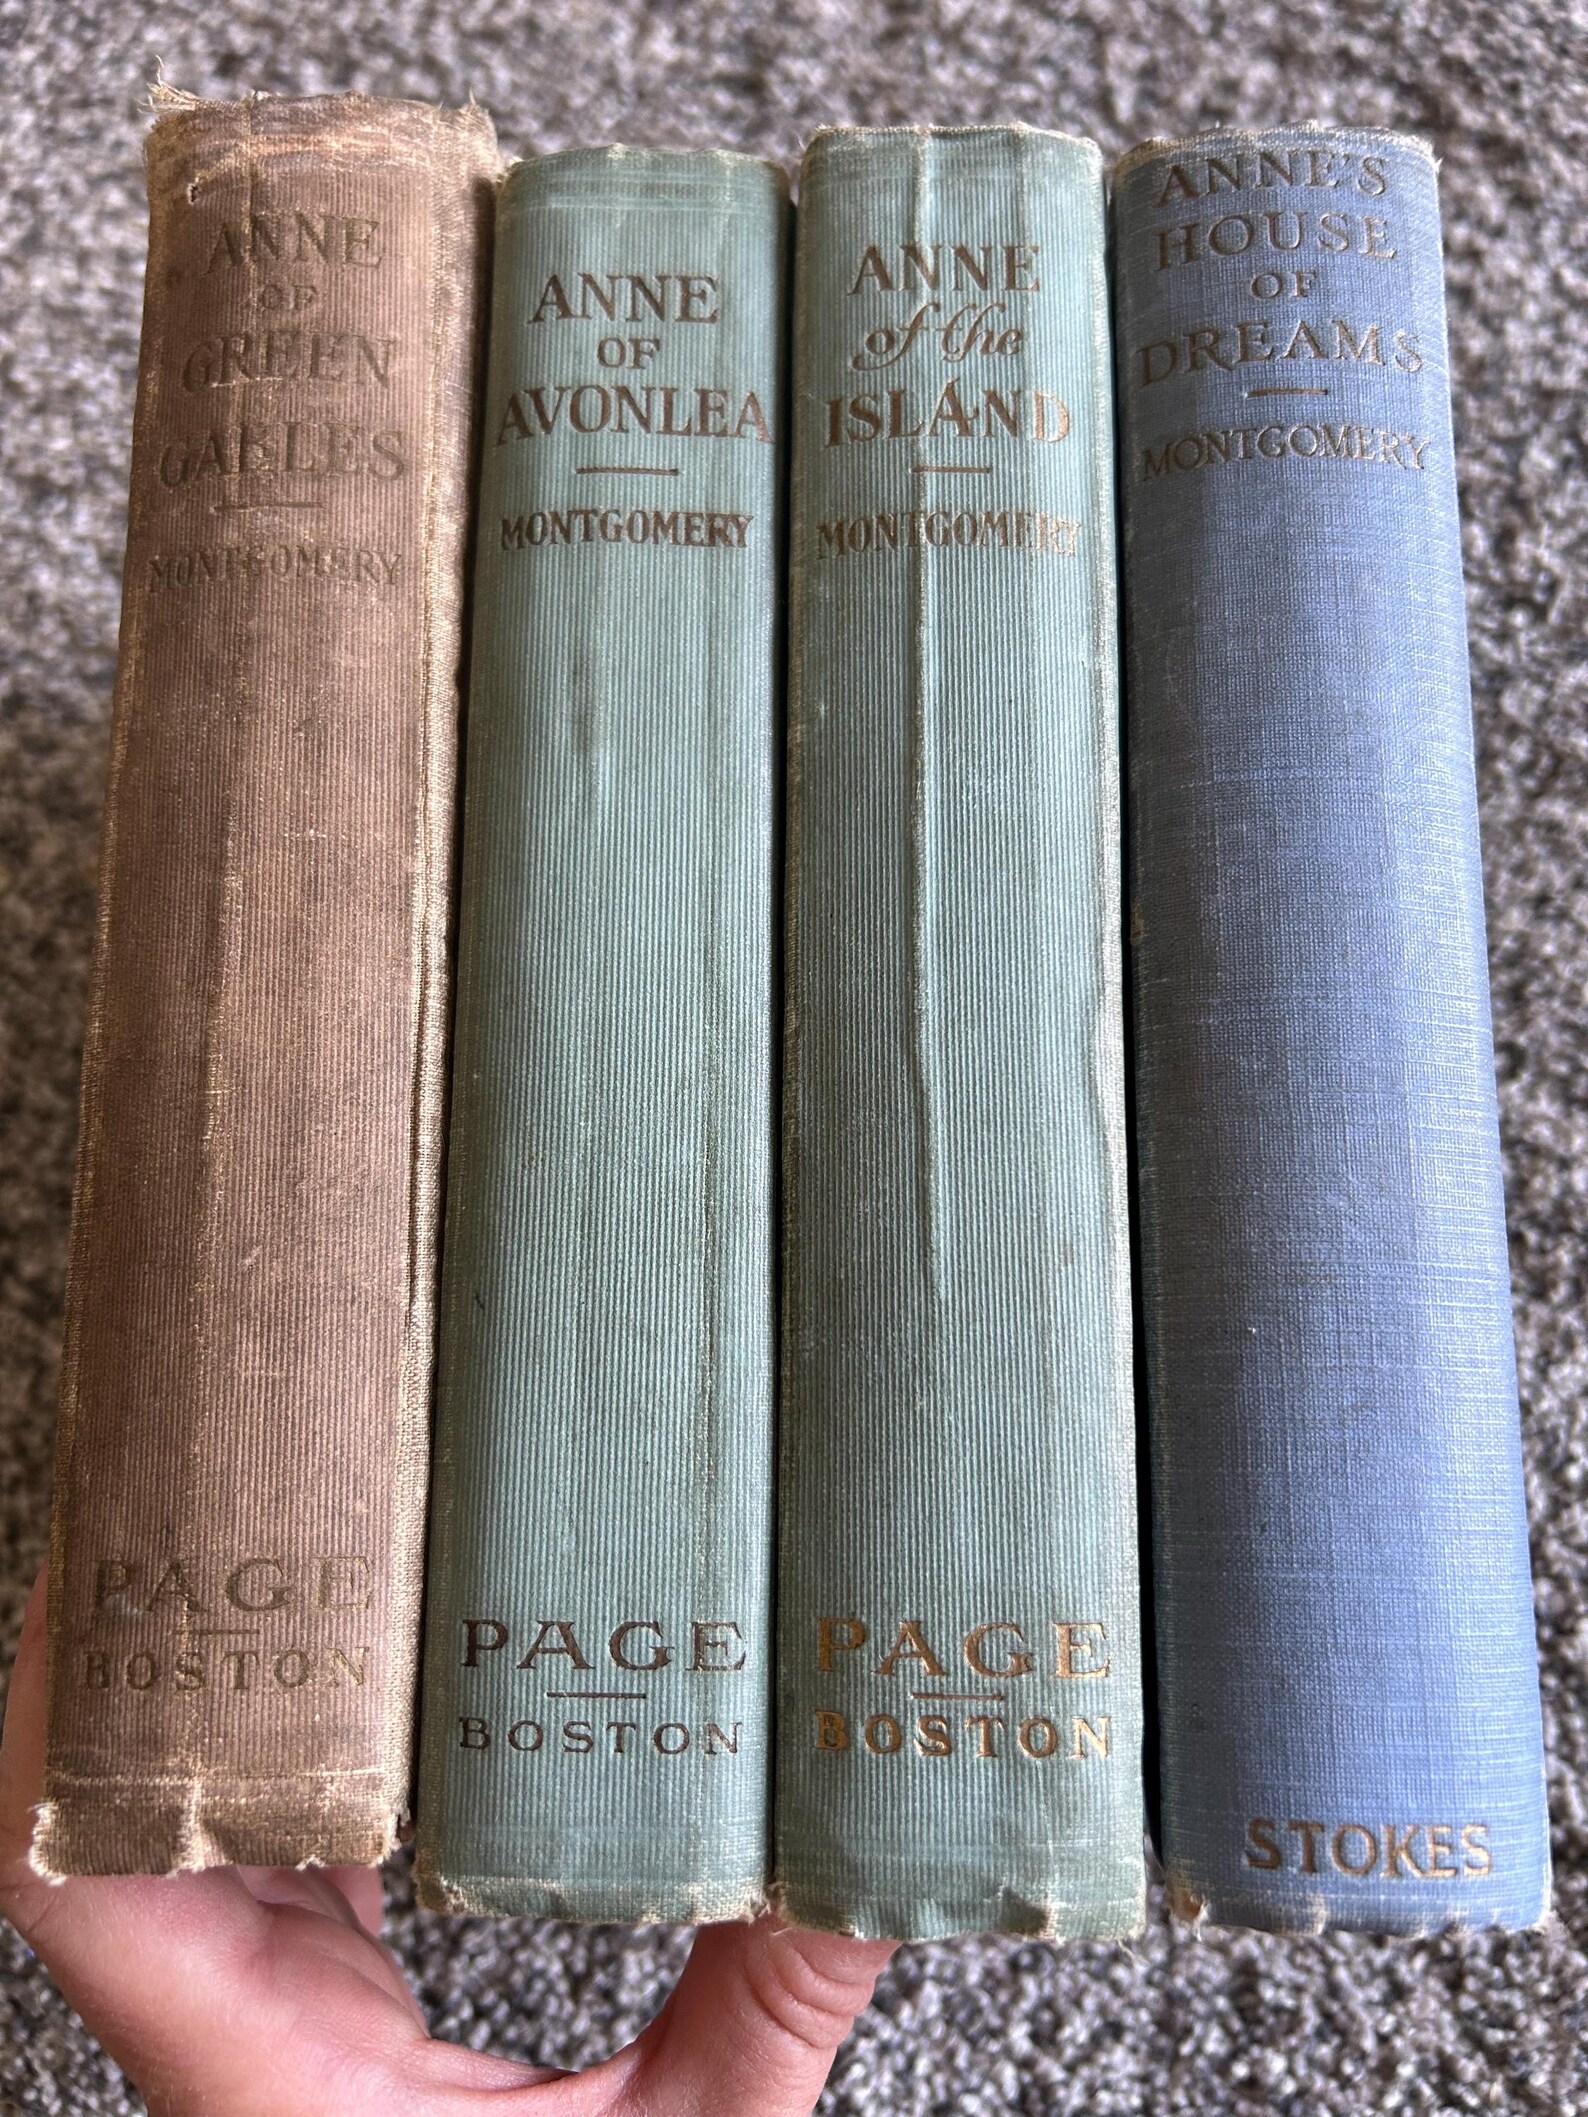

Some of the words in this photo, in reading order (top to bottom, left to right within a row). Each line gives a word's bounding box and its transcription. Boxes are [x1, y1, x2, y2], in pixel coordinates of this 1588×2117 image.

[1152, 150, 1388, 208] ANNE'S
[203, 212, 382, 276] ANNE
[1155, 211, 1397, 271] HOUSE
[260, 284, 316, 310] OF
[847, 244, 1040, 296] ANNE
[1251, 269, 1317, 300] OF
[526, 272, 718, 325] ANNE
[183, 331, 395, 392] GREEN
[597, 337, 660, 369] OF
[851, 302, 941, 371] of
[936, 302, 1022, 363] the
[1137, 319, 1424, 387] DREAMS
[496, 384, 775, 446] AVONLEA
[825, 377, 1070, 448] ISLAND
[161, 421, 404, 486] GABLES
[1143, 424, 1431, 482] MONTGOMERY
[501, 508, 753, 549] MONTGOMERY
[816, 510, 1081, 559] MONTGOMERY
[149, 545, 401, 592] MONTGOMERY
[96, 1556, 371, 1612] PAGE
[85, 1646, 370, 1690] BOSTON
[461, 1618, 747, 1671] PAGE
[816, 1616, 1111, 1679] PAGE
[458, 1716, 743, 1755] BOSTON
[814, 1710, 1111, 1759] BOSTON
[1243, 1817, 1493, 1879] STOKES
